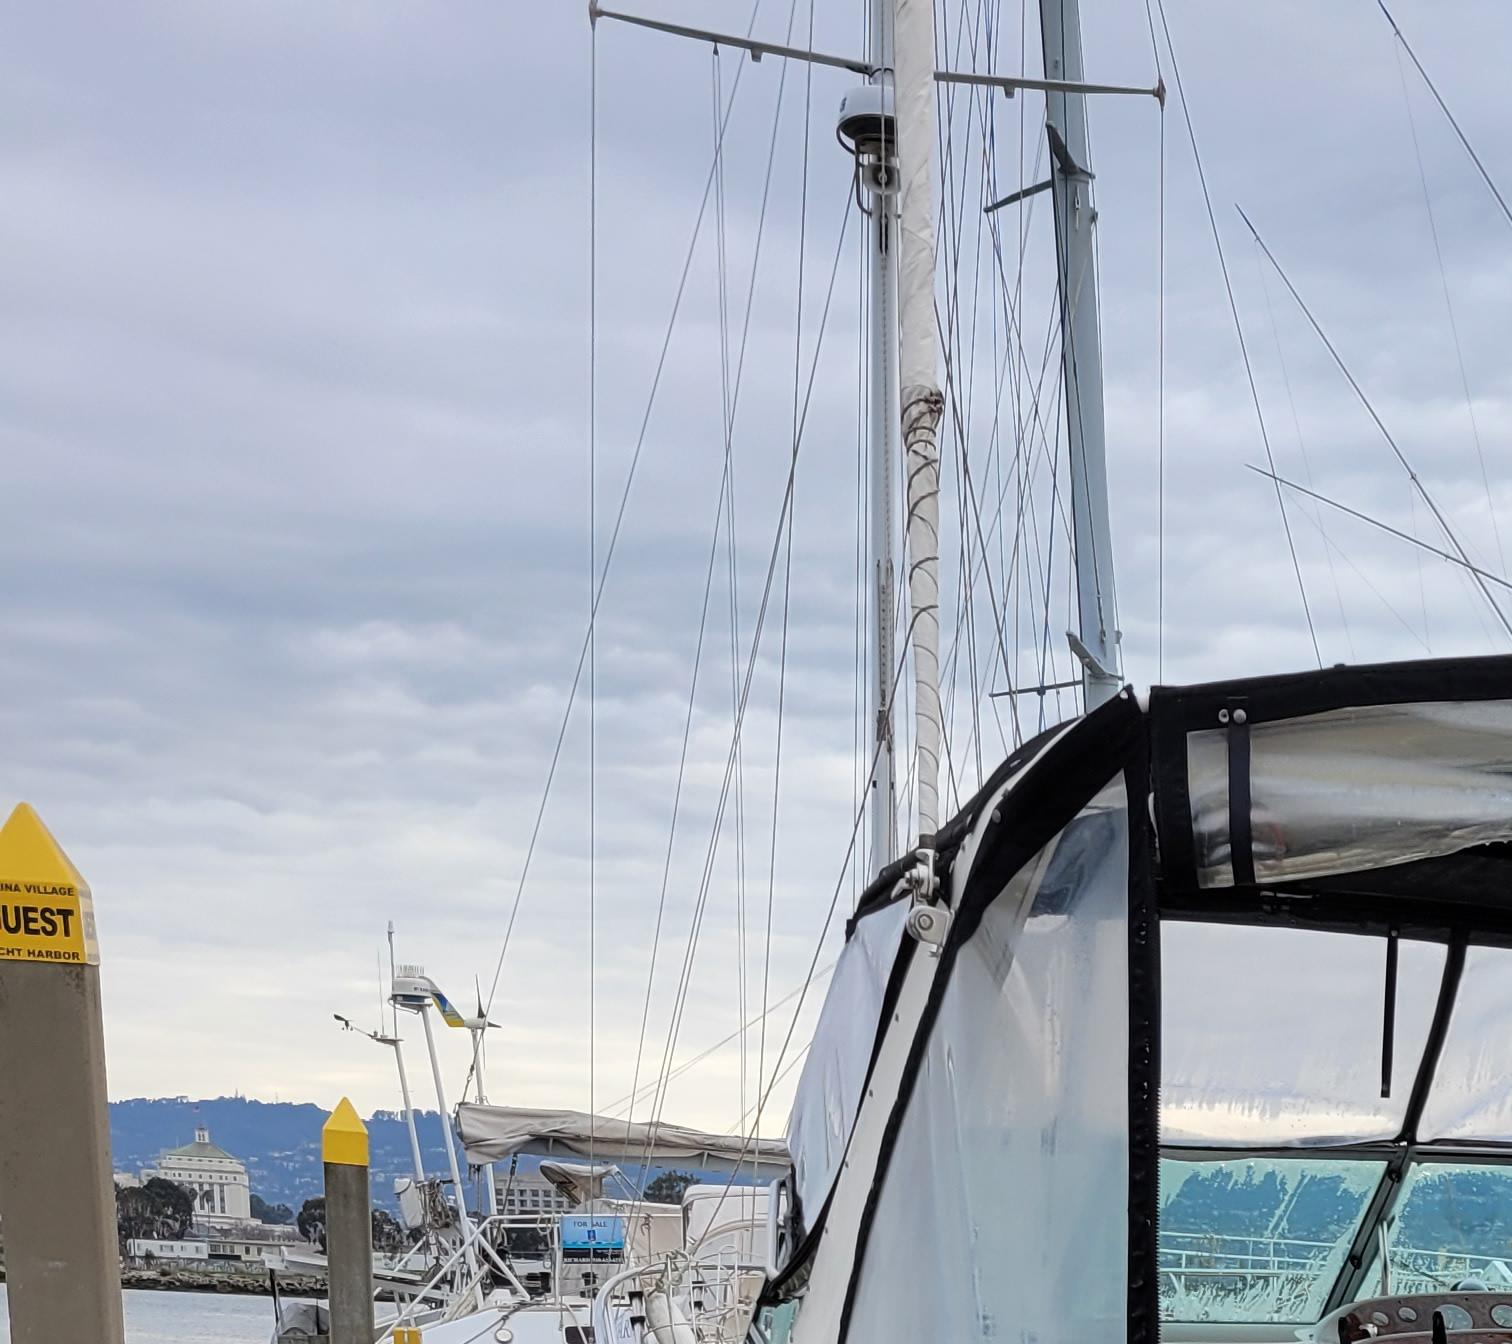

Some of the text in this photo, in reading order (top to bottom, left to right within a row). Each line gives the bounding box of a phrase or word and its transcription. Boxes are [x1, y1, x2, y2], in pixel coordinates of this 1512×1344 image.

[24, 884, 75, 896] VILLAGE
[0, 904, 75, 938] UEST
[27, 949, 80, 960] HARBOR
